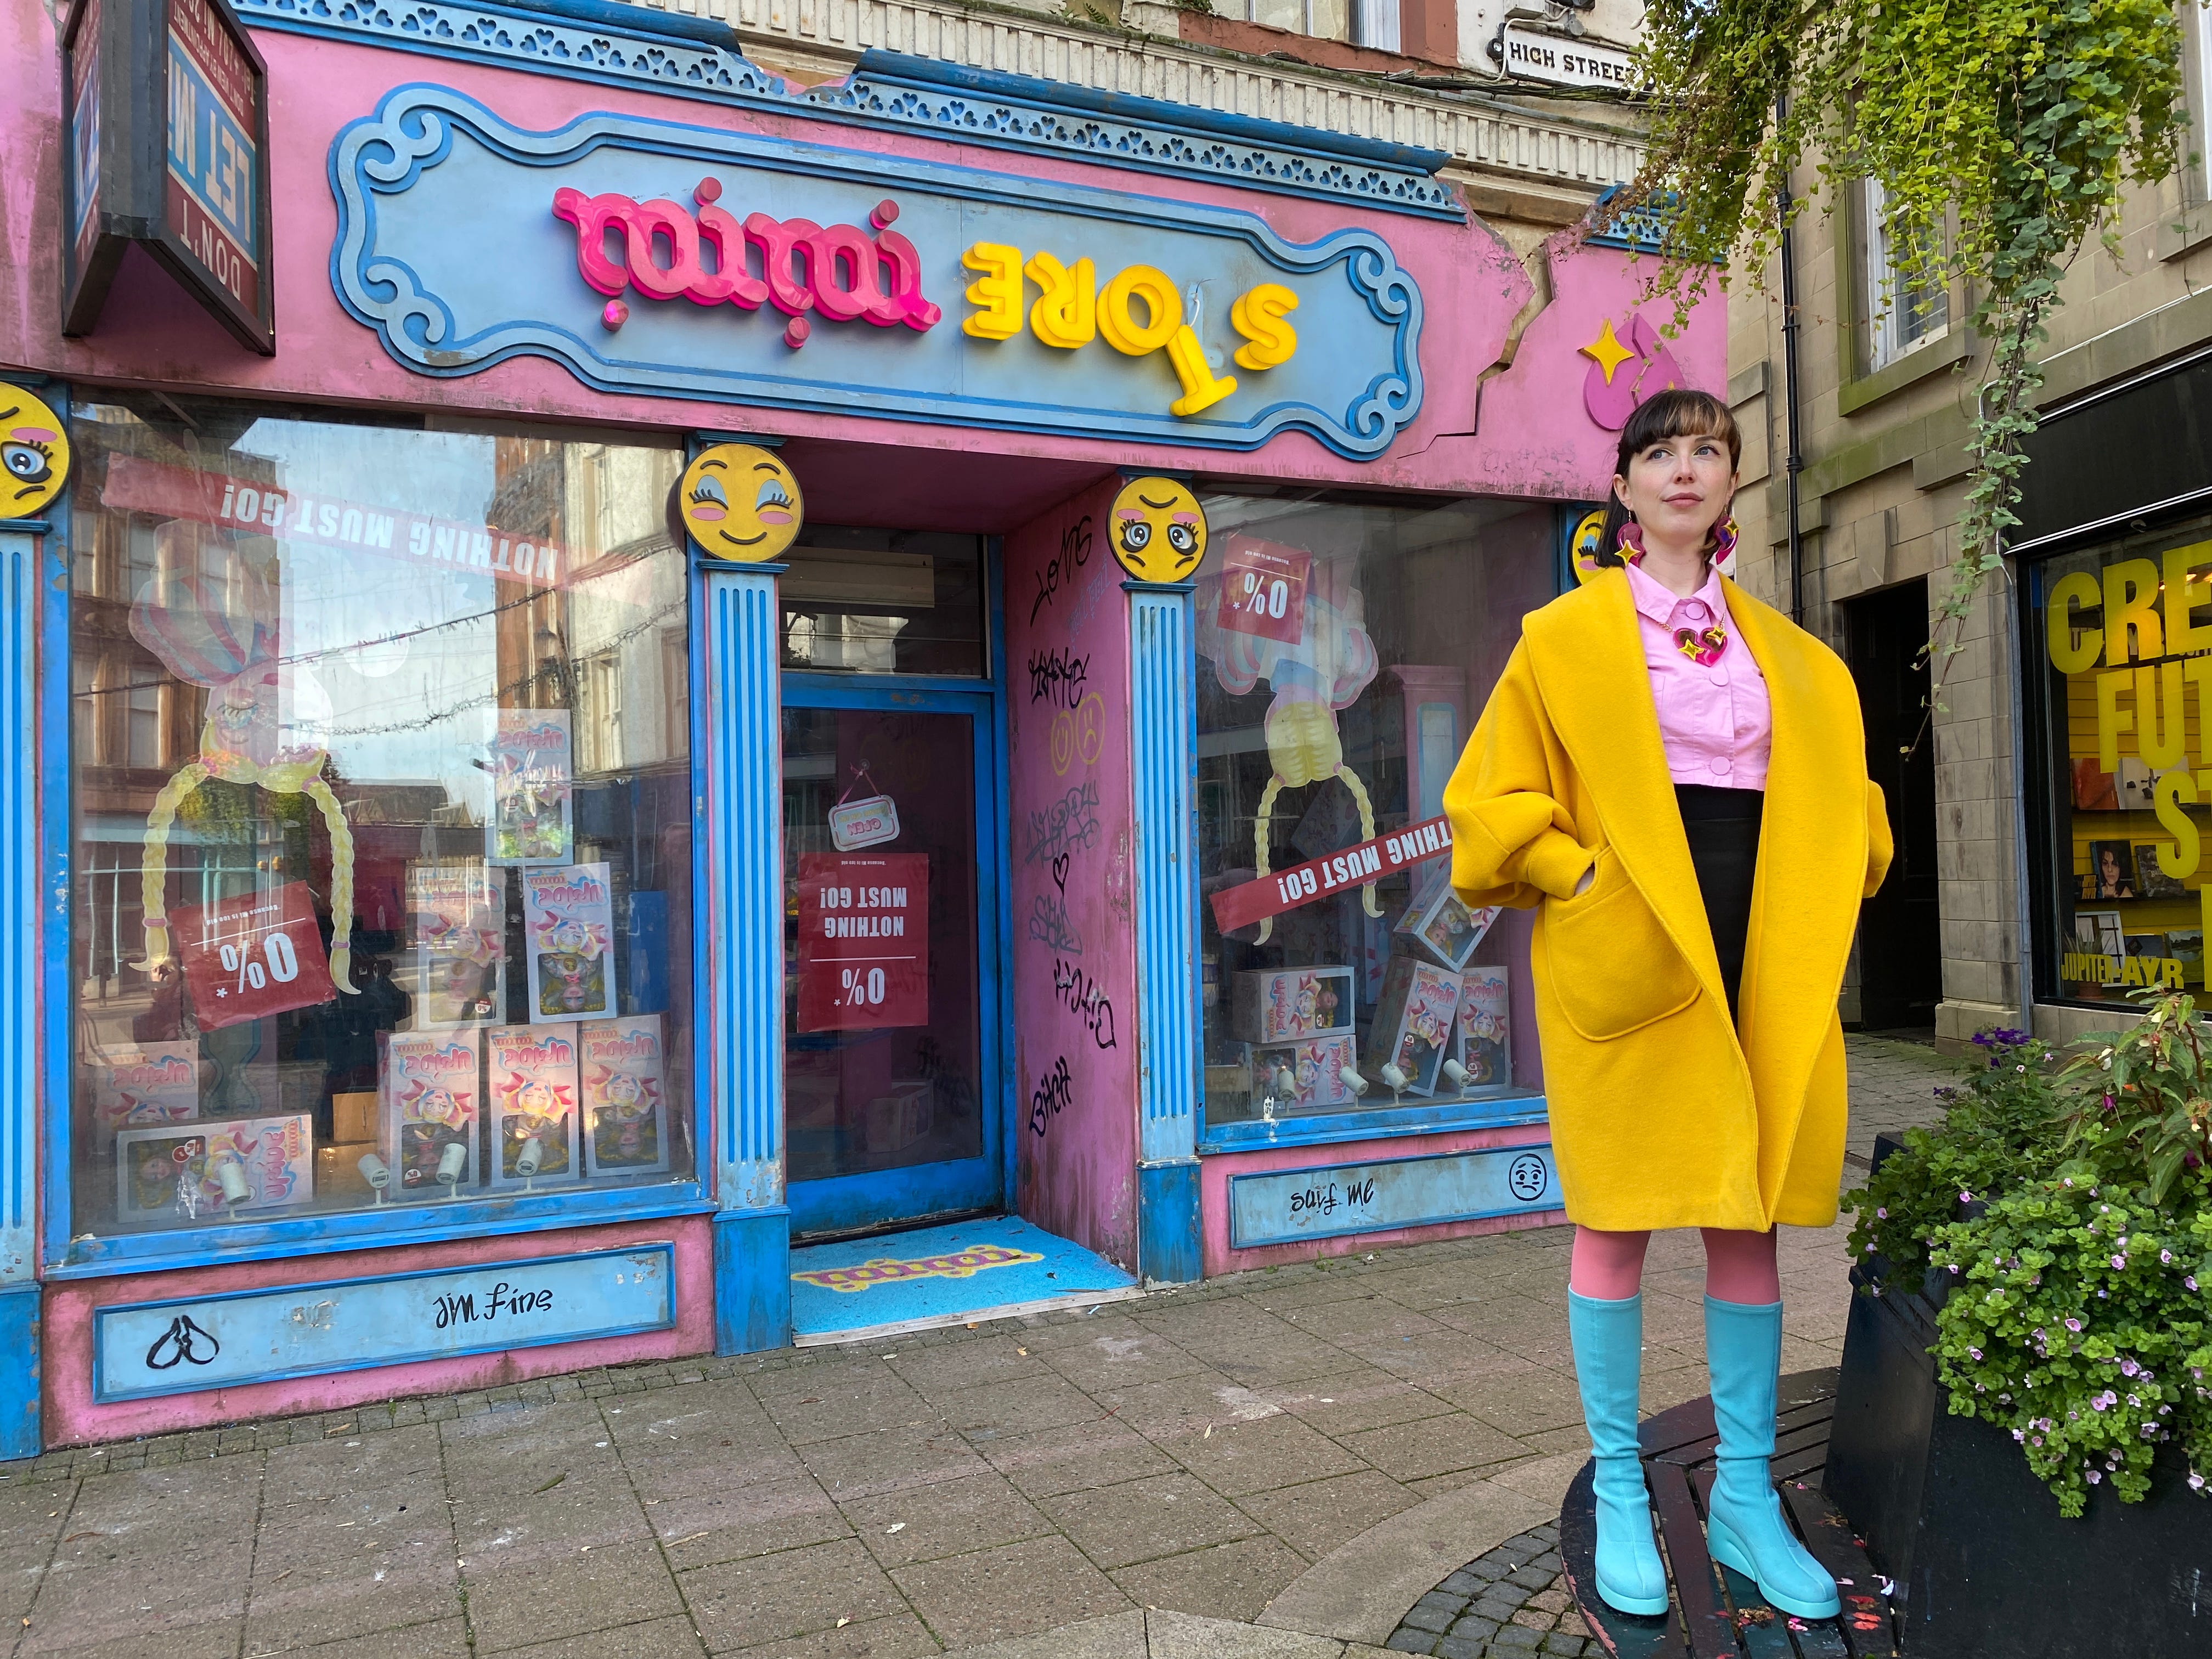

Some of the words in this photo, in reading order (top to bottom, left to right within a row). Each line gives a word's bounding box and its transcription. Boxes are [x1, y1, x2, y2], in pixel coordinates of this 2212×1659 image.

[1509, 42, 1555, 68] HIGH
[1562, 54, 1636, 82] STREE
[205, 109, 250, 244] LET
[180, 199, 240, 301] DON'T
[962, 241, 1299, 416] STORE
[220, 484, 285, 527] GO!
[294, 499, 394, 549] MUST
[409, 521, 558, 581] NOTHING
[847, 817, 882, 836] OPEN
[1386, 821, 1453, 865] THING
[1277, 868, 1318, 904] GO!
[1322, 845, 1381, 889] MUST
[820, 887, 851, 909] GO!
[857, 887, 907, 908] MUST
[825, 916, 904, 938] NOTHING
